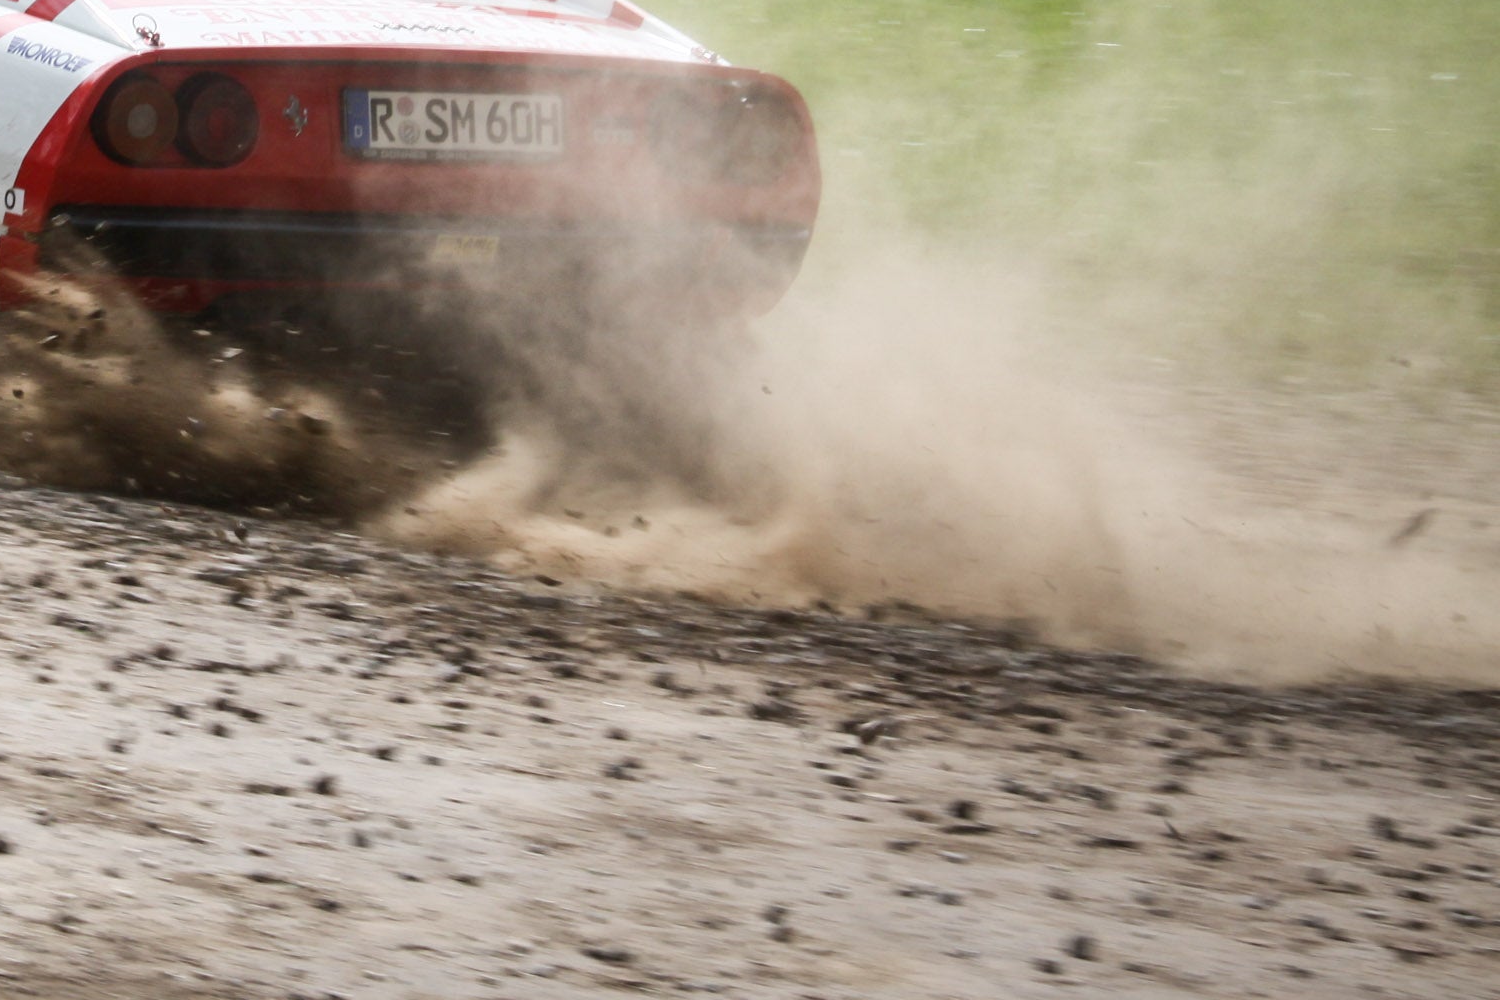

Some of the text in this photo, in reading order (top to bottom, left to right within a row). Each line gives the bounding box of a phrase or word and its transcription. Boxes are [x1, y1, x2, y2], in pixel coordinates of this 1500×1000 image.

[13, 39, 80, 72] MONROE
[354, 125, 363, 138] D
[371, 98, 395, 142] R
[425, 99, 476, 143] SM
[486, 101, 559, 145] 60H
